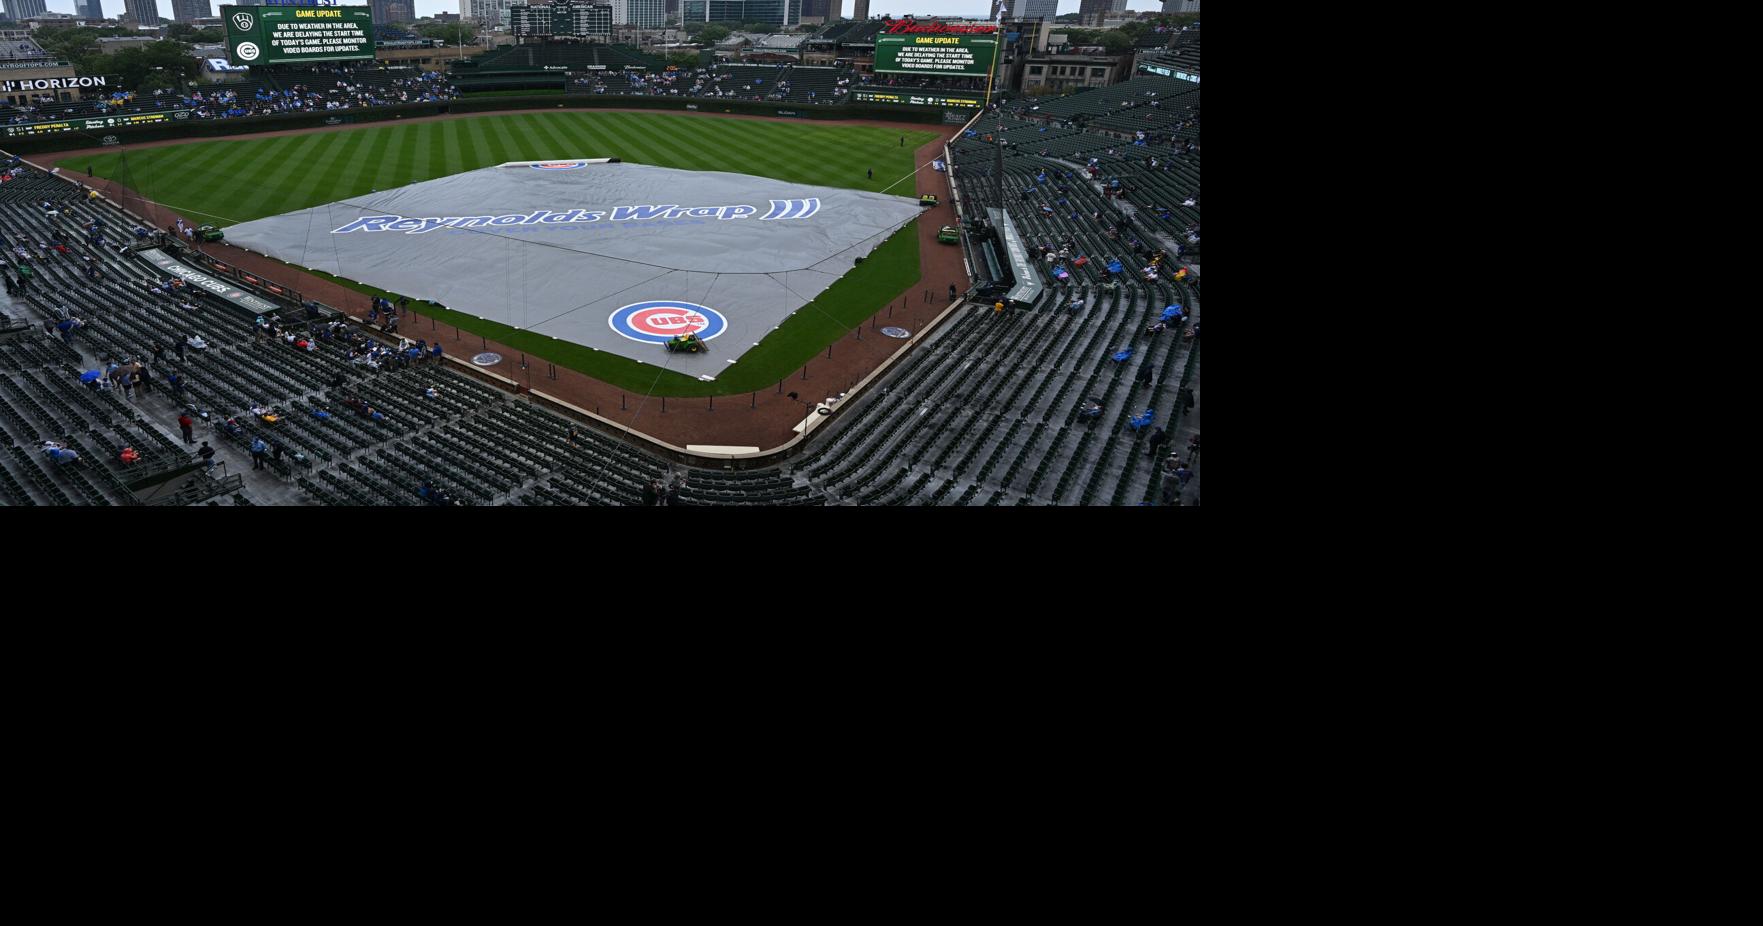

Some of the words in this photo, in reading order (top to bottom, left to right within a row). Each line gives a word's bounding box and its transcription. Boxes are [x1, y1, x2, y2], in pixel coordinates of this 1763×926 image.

[20, 76, 106, 90] HORIZON
[330, 209, 606, 234] Reynolds
[610, 204, 757, 220] Wrap
[168, 266, 207, 281] CHICAGO
[200, 280, 230, 293] CUBS
[632, 308, 704, 335] CUBS
